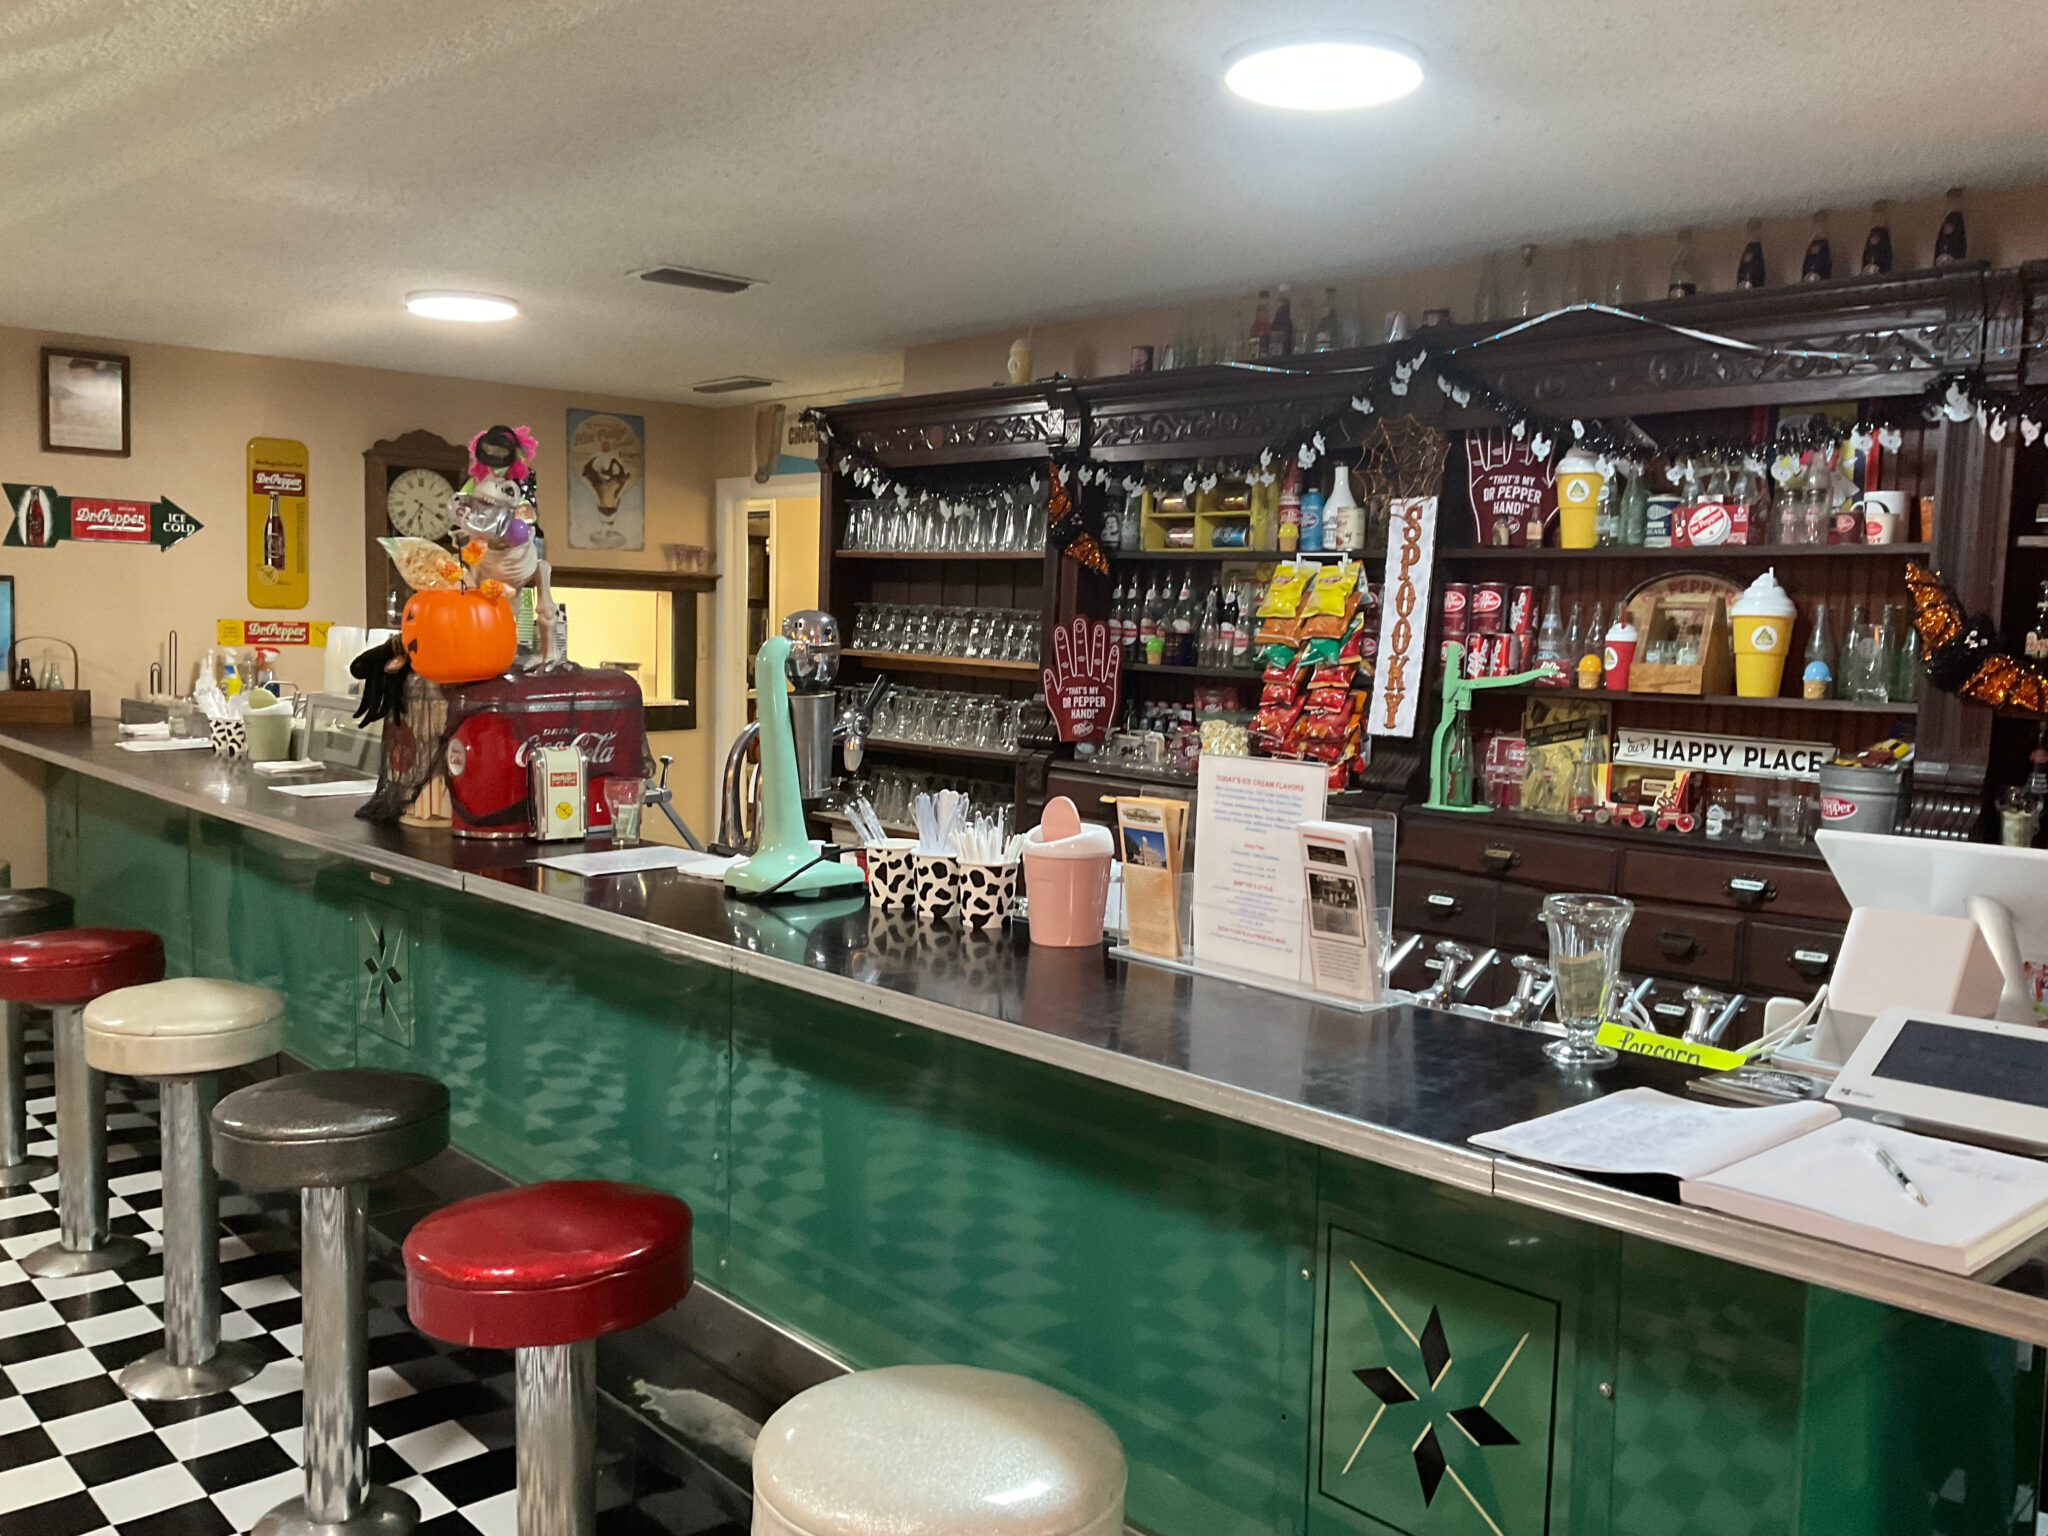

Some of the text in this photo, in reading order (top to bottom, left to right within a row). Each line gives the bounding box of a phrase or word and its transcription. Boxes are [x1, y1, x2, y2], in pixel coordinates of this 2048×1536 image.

[1522, 476, 1536, 486] MY
[1483, 485, 1542, 504] DR PEPPER
[168, 513, 187, 523] ICE
[162, 522, 196, 534] COLD
[1383, 504, 1423, 729] SPOOKY
[1088, 686, 1098, 695] MY
[1073, 696, 1106, 708] PEPPER
[1653, 738, 1734, 765] HAPPY
[1743, 747, 1824, 773] PLACE
